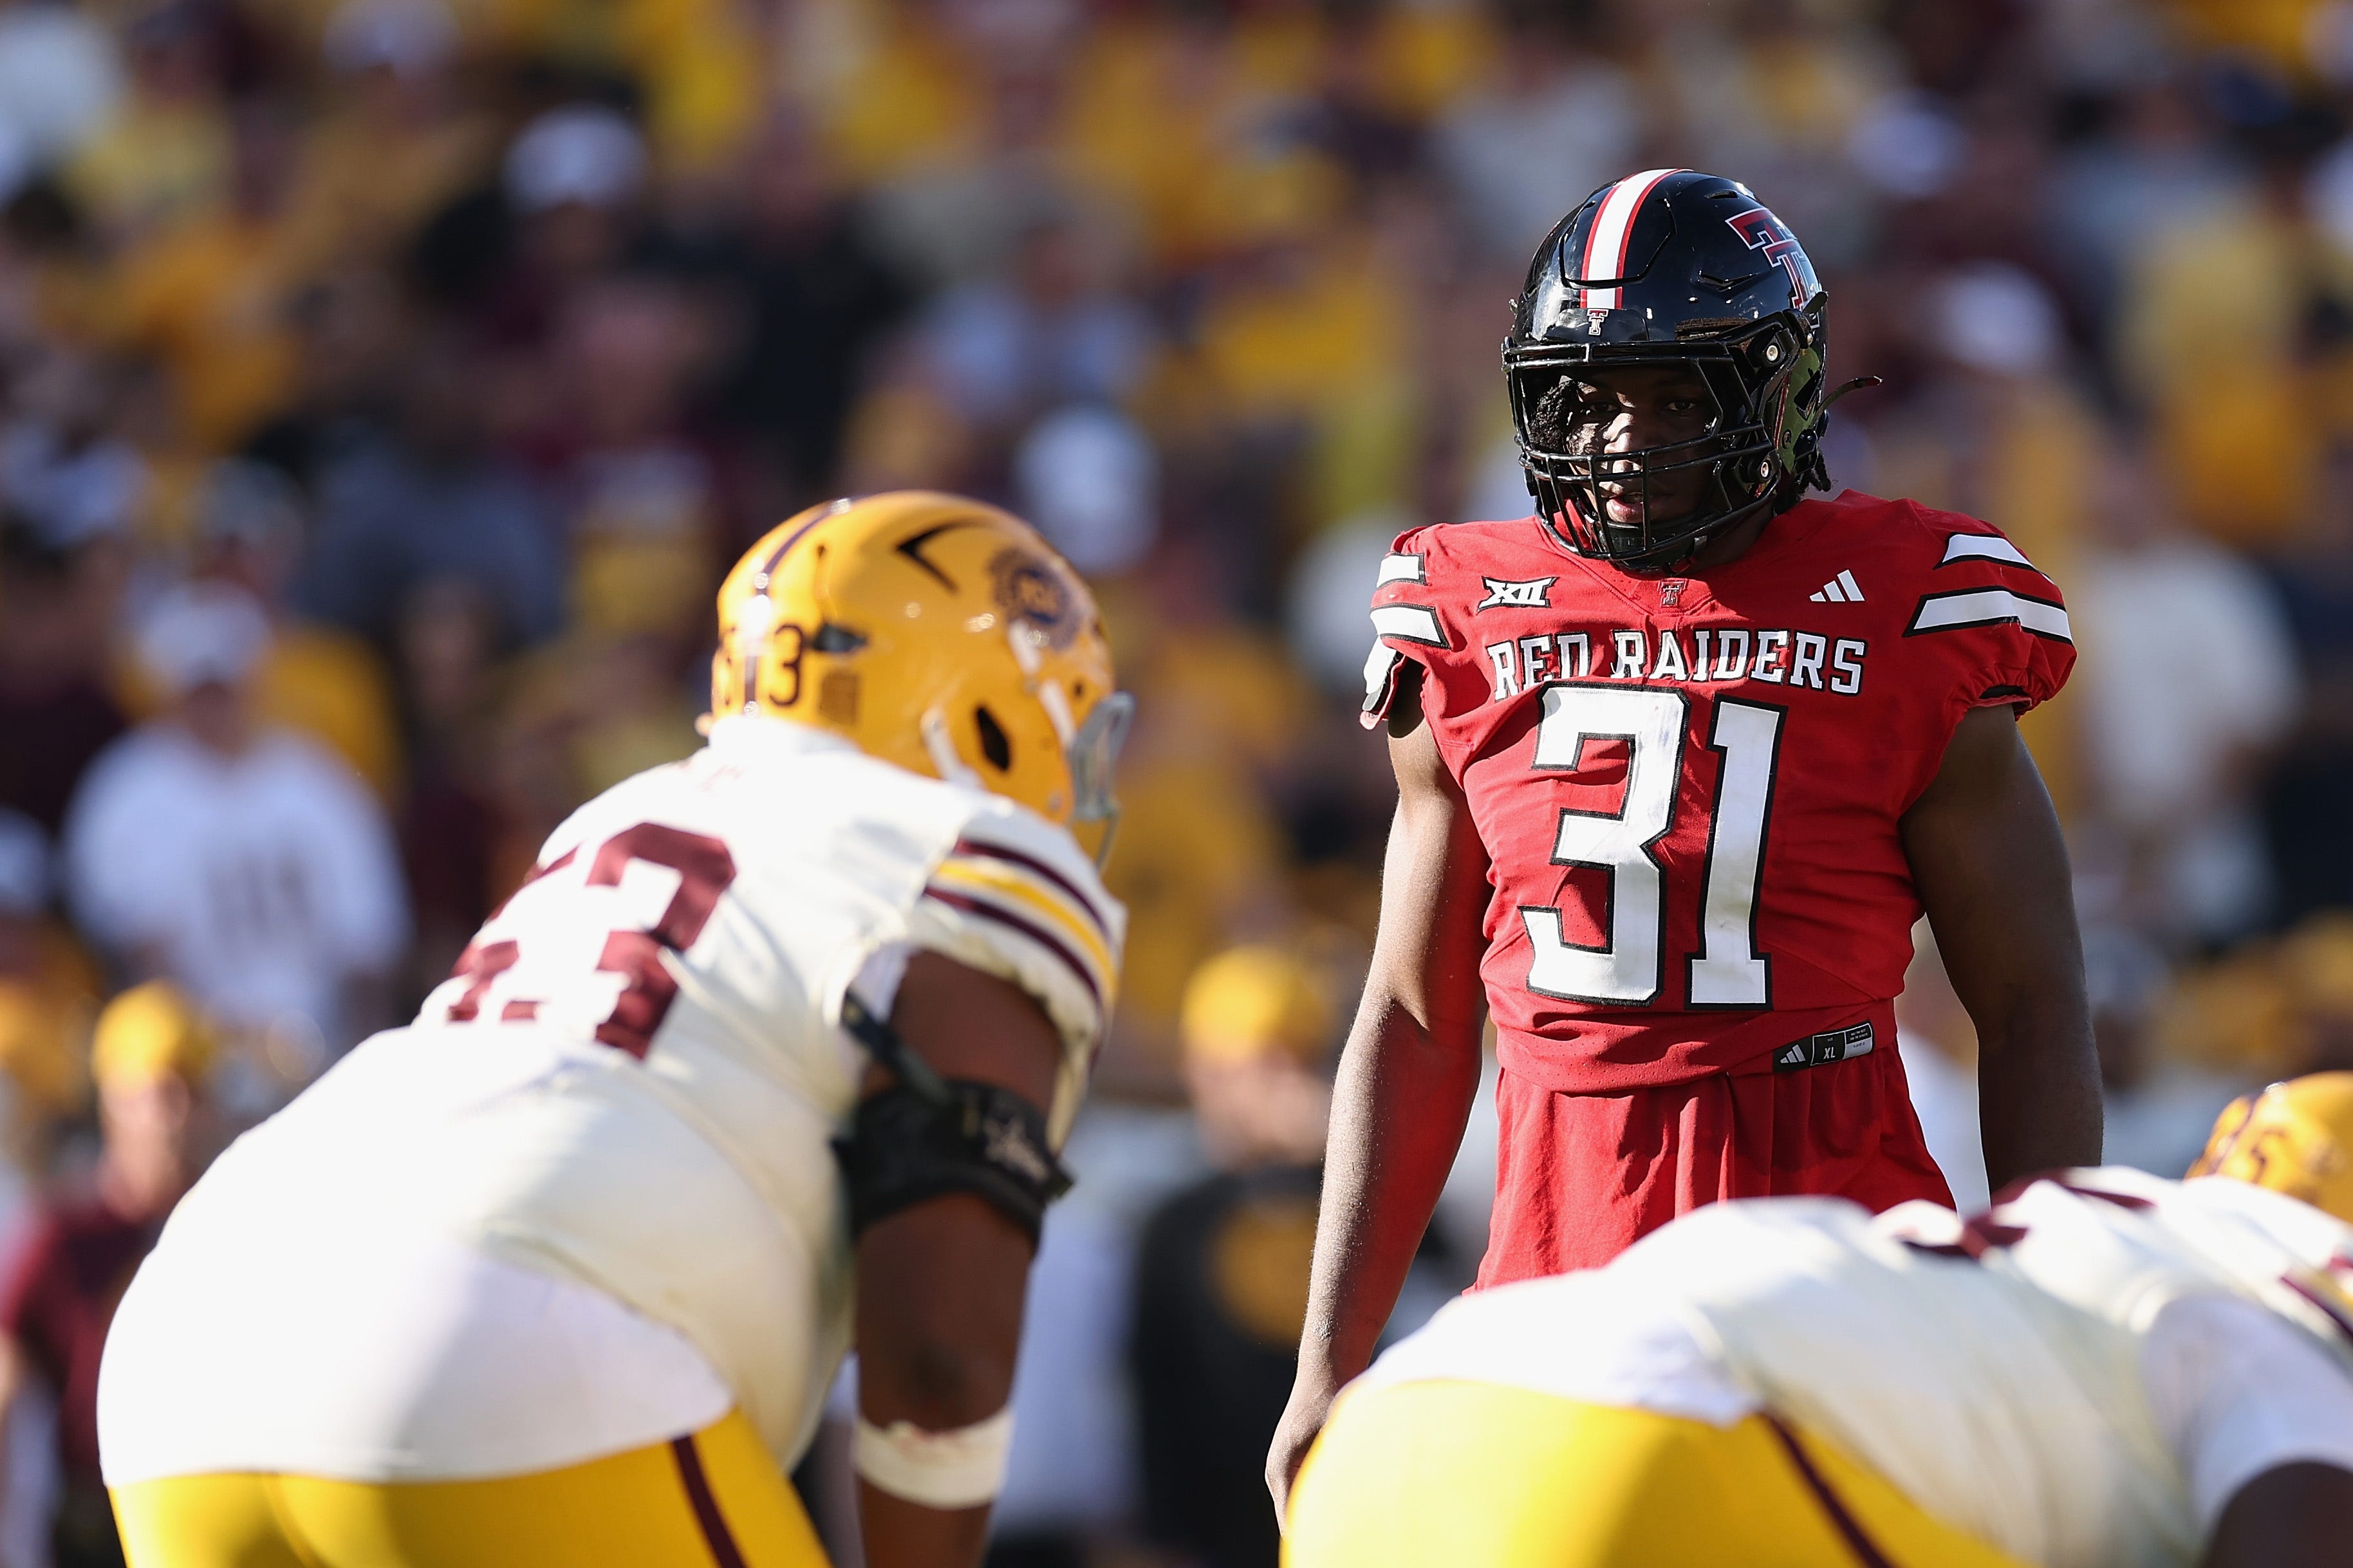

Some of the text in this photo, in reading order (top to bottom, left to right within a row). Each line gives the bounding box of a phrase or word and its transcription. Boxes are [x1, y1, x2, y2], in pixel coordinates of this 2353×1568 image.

[1487, 628, 1866, 703] RED RAIDERS
[1518, 681, 1788, 1011] 31
[1823, 1046, 1836, 1060] XL
